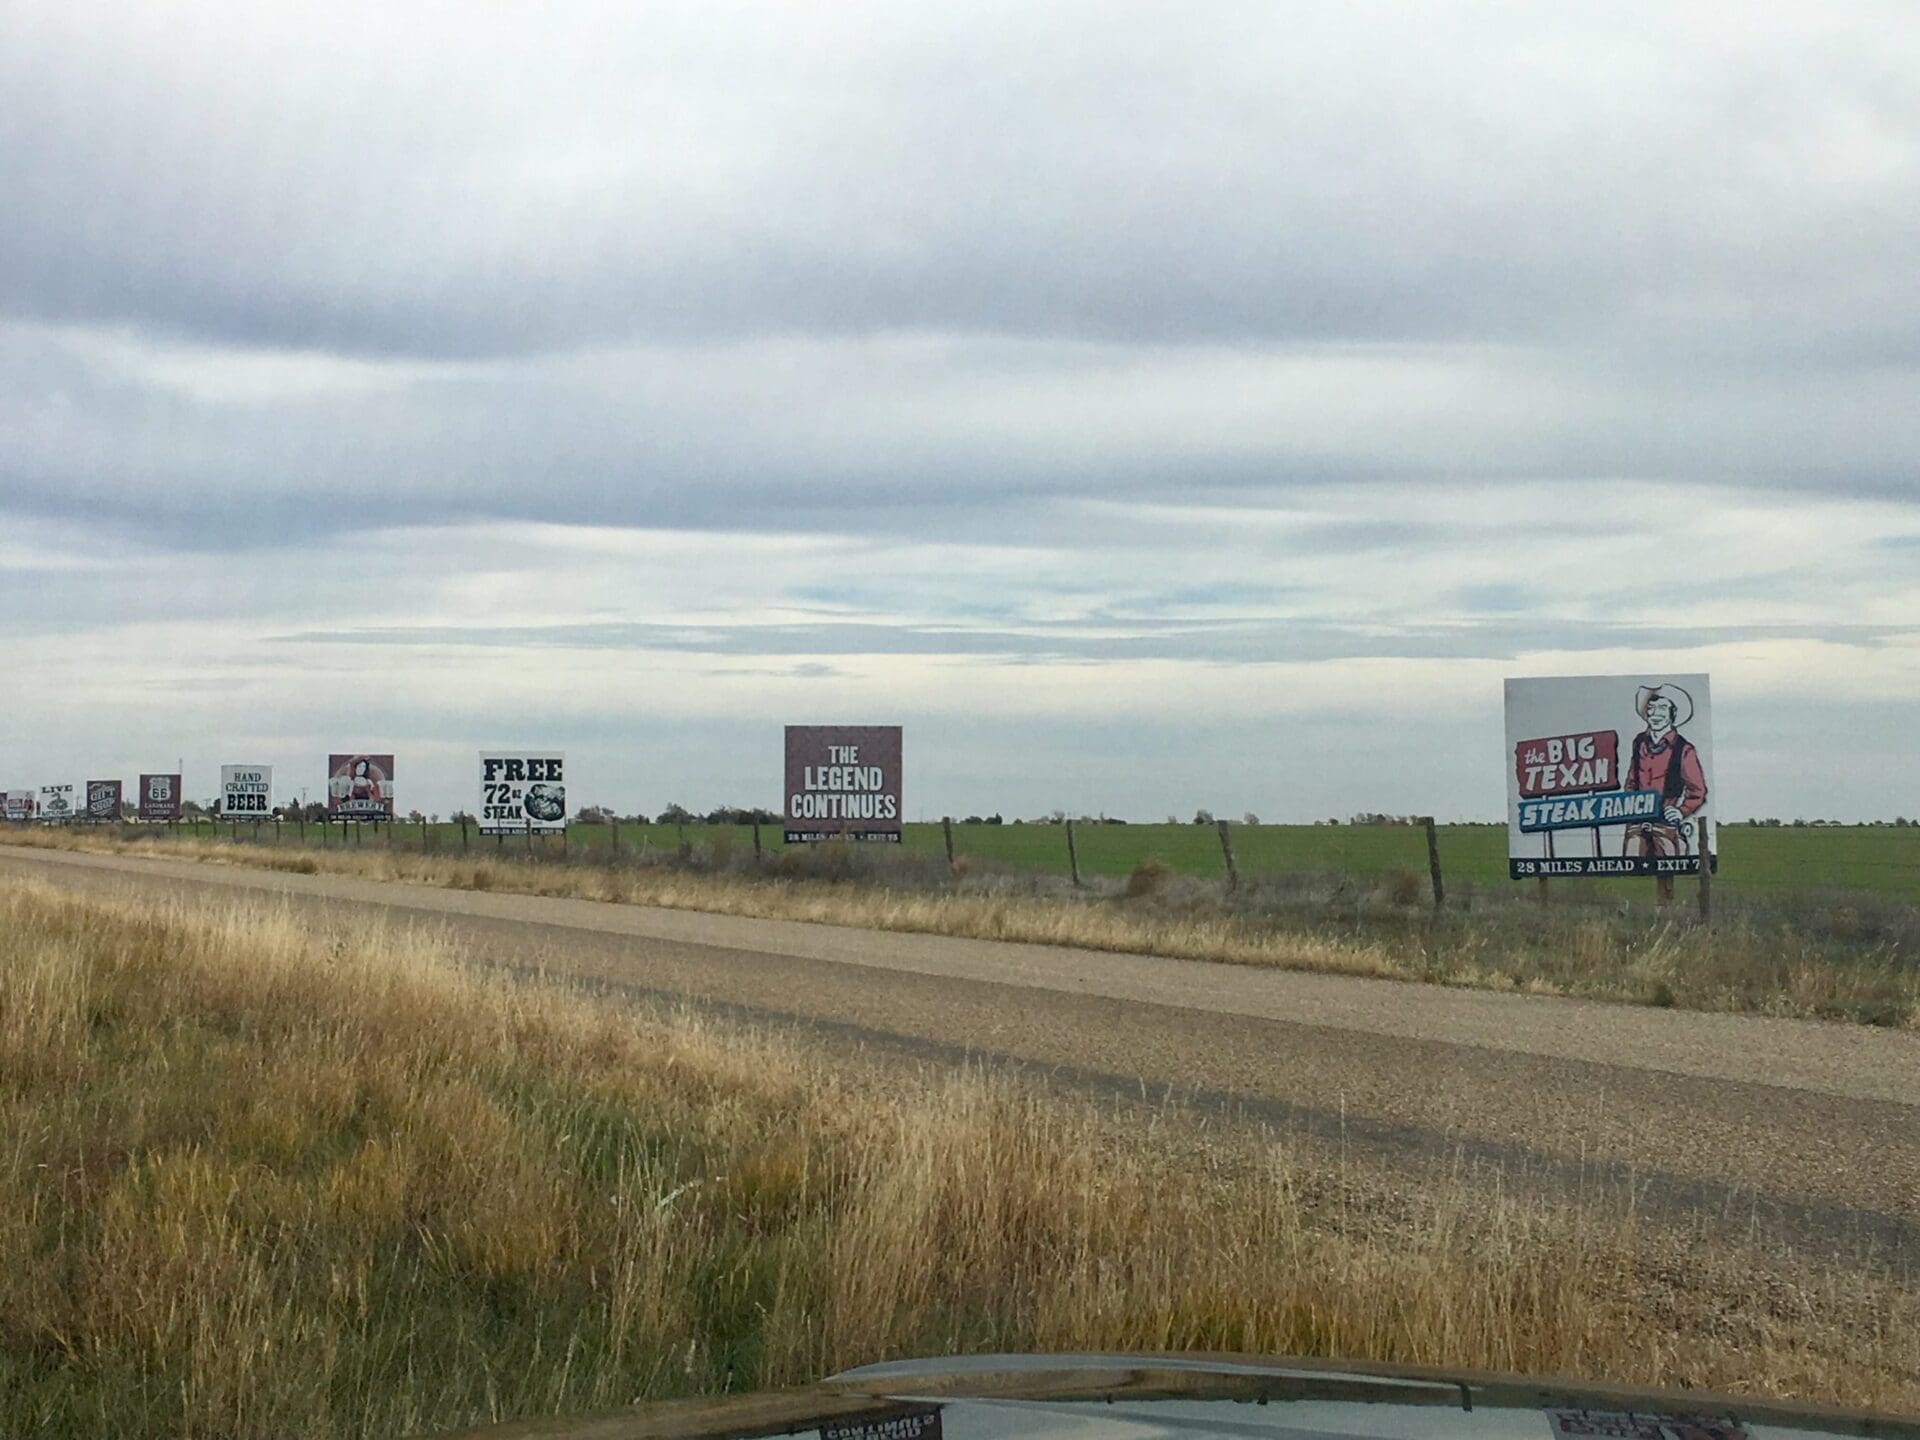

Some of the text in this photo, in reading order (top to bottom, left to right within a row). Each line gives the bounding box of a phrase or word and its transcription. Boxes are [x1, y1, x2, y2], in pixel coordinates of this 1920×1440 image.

[828, 745, 858, 764] THE
[1524, 736, 1595, 764] the BIG
[234, 773, 261, 782] HAND
[484, 759, 562, 781] FREE
[804, 766, 883, 791] LEGEND
[1525, 759, 1609, 791] TEXAN
[41, 785, 73, 794] LIVE
[152, 788, 168, 799] 66
[225, 782, 269, 792] CRAFTED
[484, 784, 511, 804] 72
[90, 799, 116, 812] SHOP
[227, 793, 267, 811] BEER
[791, 794, 897, 819] CONTINUES
[1522, 793, 1655, 826] STEAK RANCH
[484, 806, 522, 819] STEAK
[1517, 862, 1535, 874] 28
[1540, 861, 1582, 873] MILES
[1587, 860, 1634, 872] AHEAD
[1658, 859, 1689, 871] EXIT
